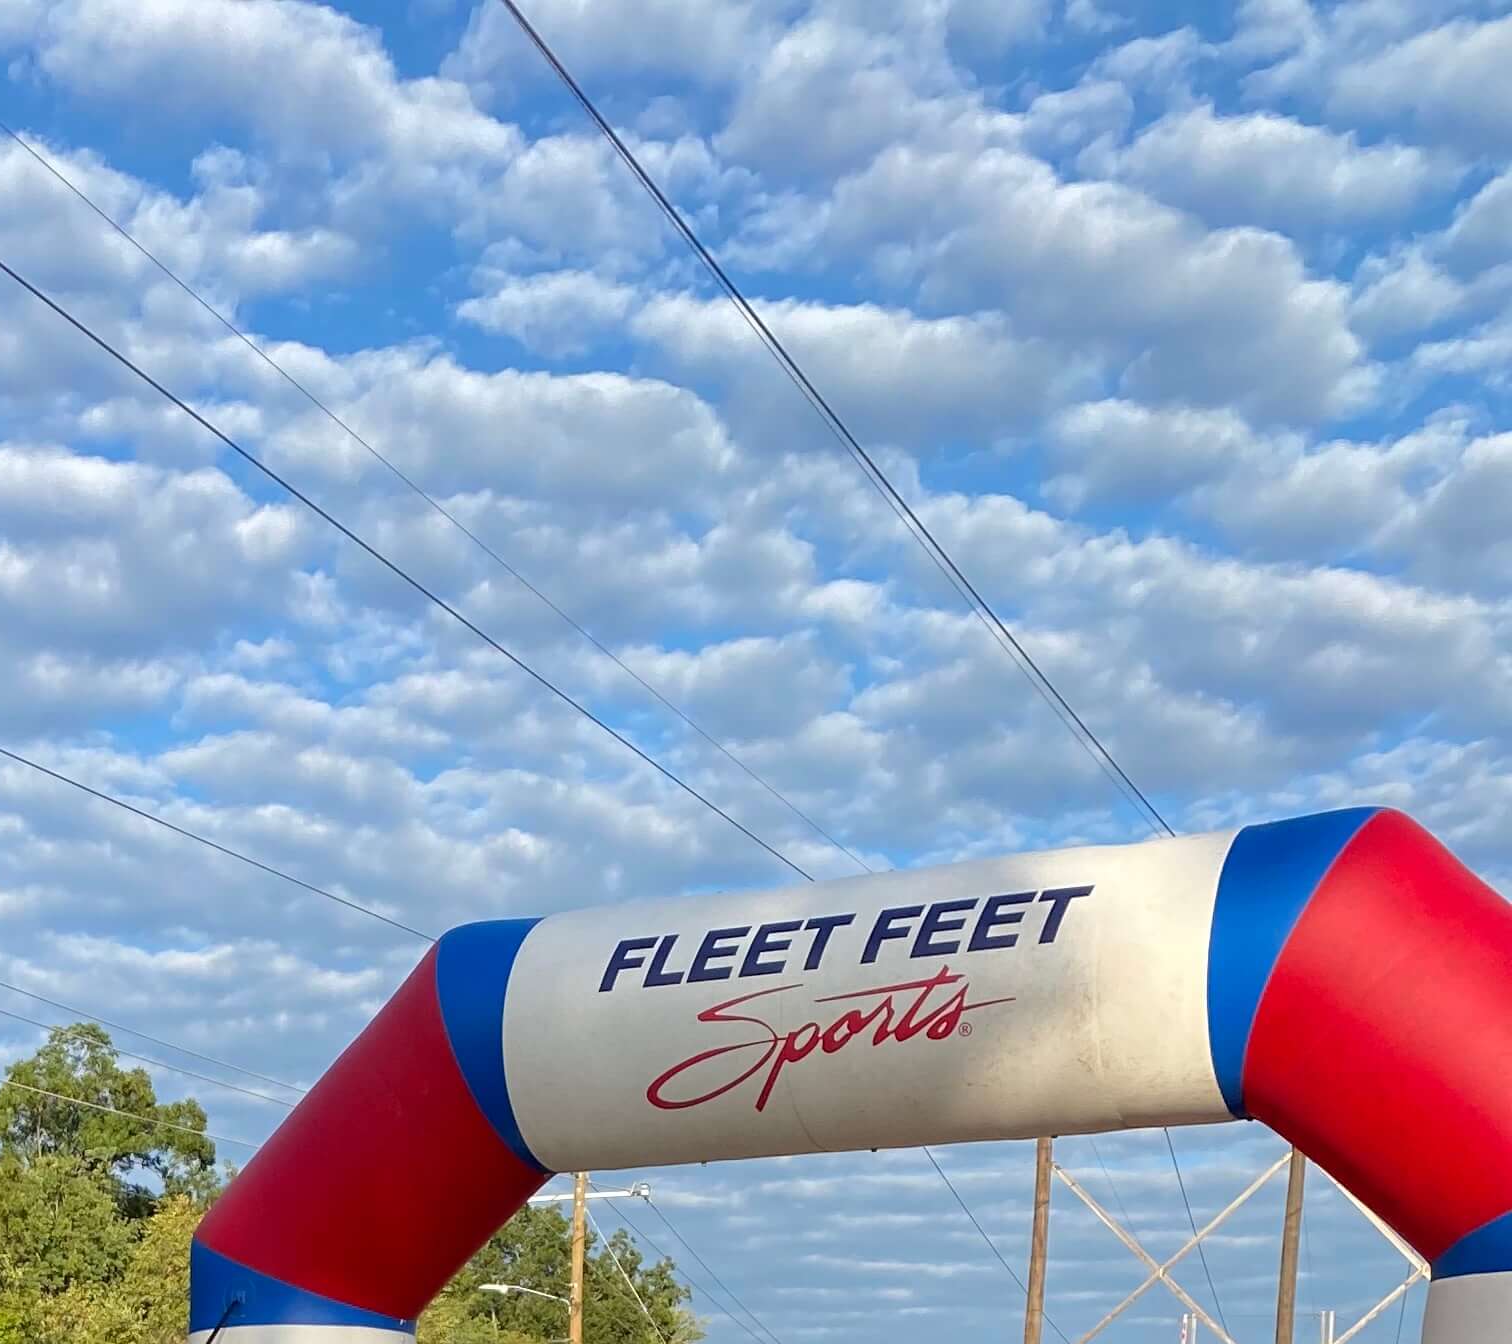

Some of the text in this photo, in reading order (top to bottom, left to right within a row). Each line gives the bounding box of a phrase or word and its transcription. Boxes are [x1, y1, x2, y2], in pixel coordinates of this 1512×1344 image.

[598, 884, 1095, 993] FLEET FEET
[646, 964, 1017, 1112] Sports
